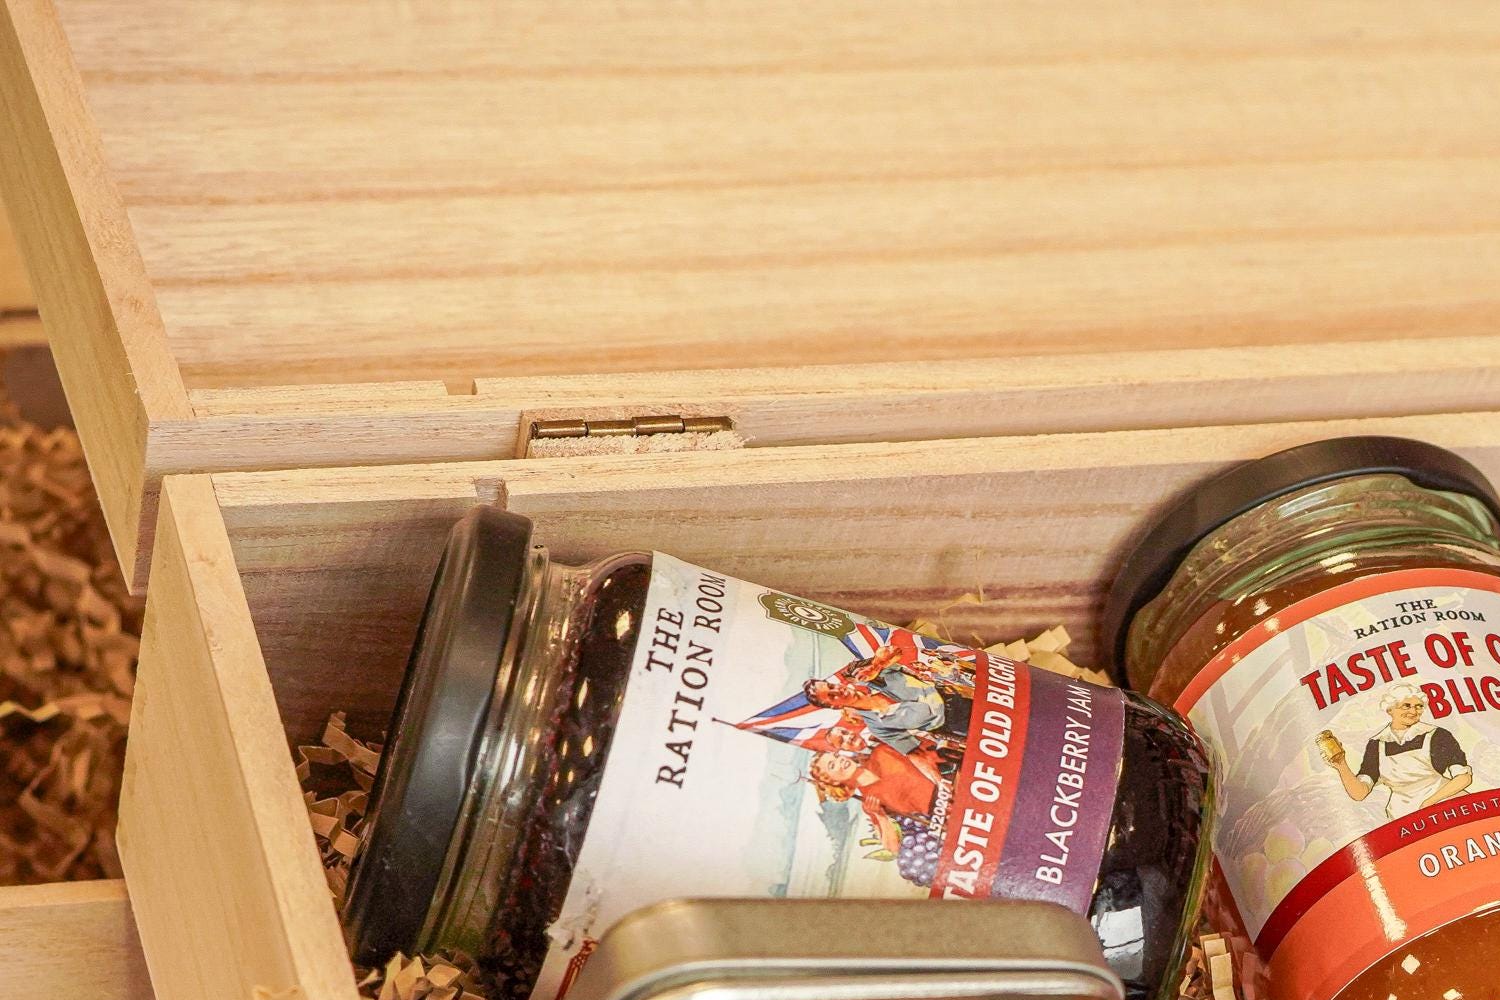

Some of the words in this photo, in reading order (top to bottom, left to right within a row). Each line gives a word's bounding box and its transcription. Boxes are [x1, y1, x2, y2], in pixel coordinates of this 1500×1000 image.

[1353, 611, 1428, 640] RATION
[1435, 609, 1487, 623] ROOM
[1395, 598, 1438, 613] THE
[645, 607, 684, 673] THE
[1300, 639, 1418, 711] TASTE
[1424, 631, 1475, 669] OF
[655, 639, 714, 790] RATION
[693, 572, 727, 634] ROOM
[978, 710, 1013, 759] OLD
[969, 761, 1003, 803] OF
[1035, 715, 1092, 885] BLACKBERRY
[1066, 684, 1092, 718] JAM
[942, 808, 995, 900] TASTE
